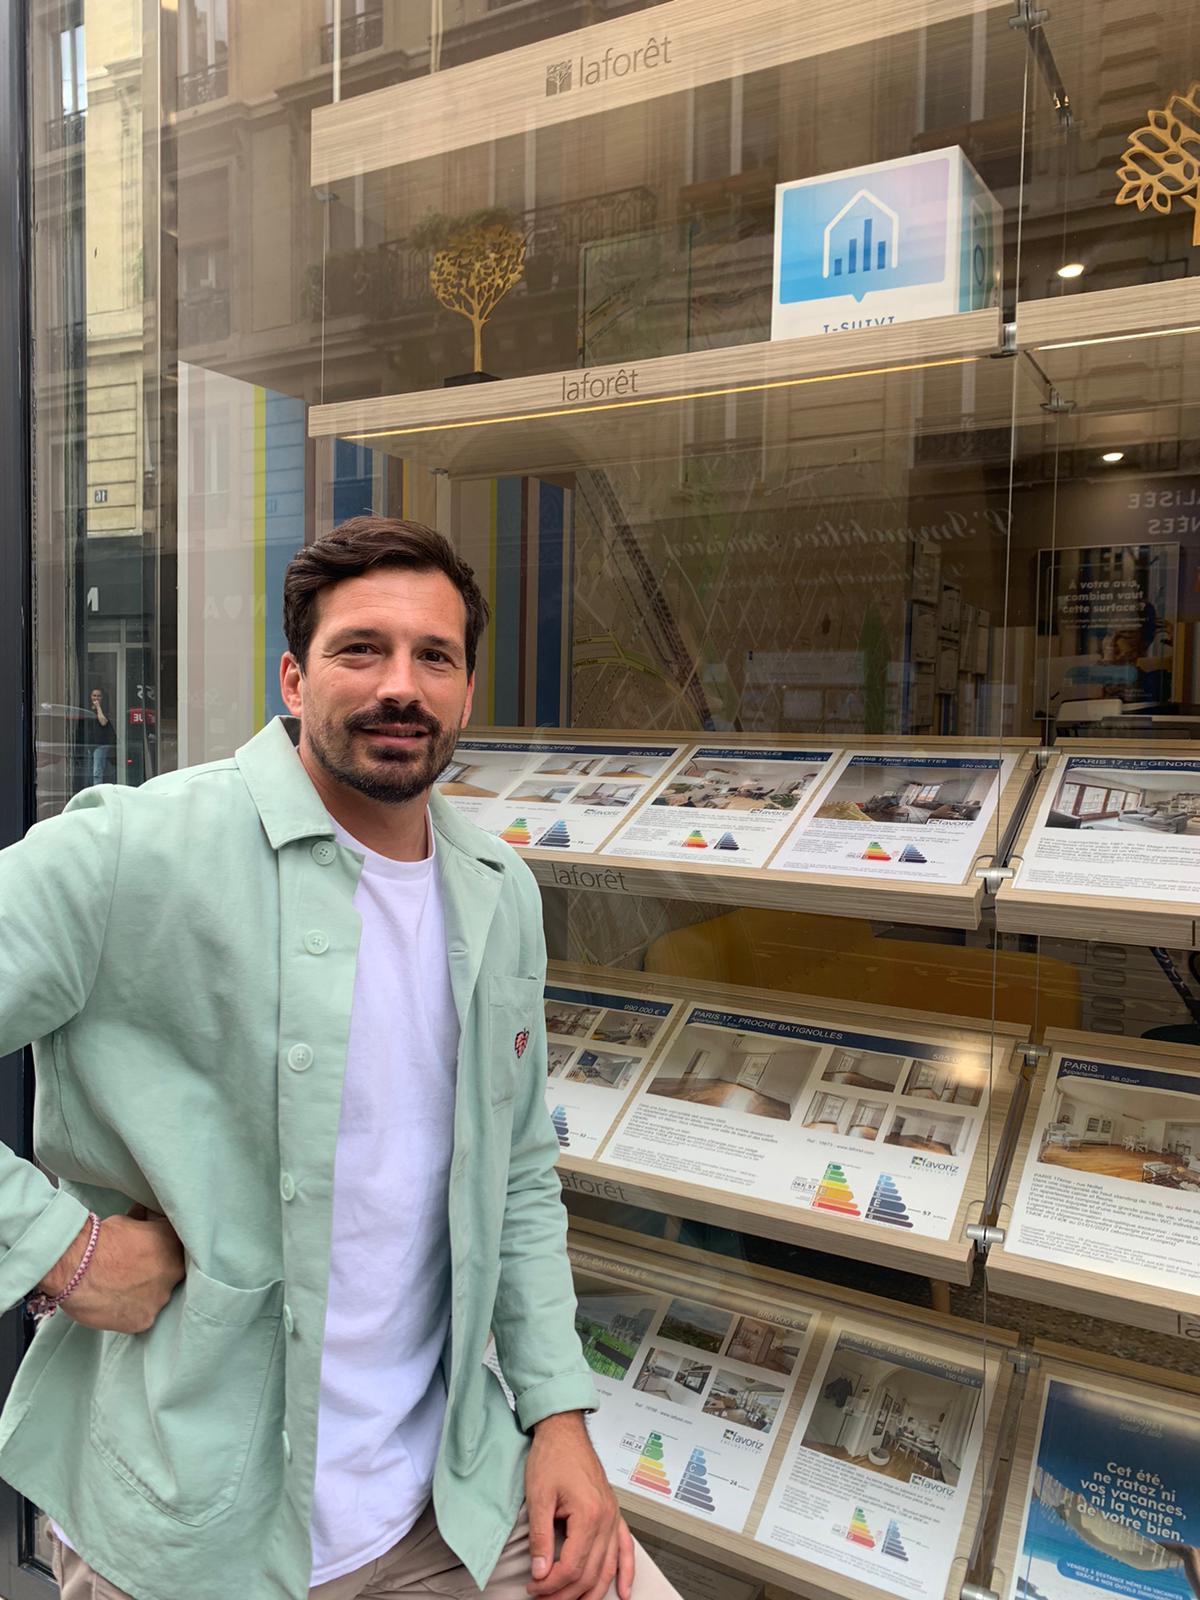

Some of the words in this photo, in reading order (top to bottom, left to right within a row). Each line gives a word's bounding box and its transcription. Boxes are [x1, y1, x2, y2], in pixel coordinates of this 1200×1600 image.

[579, 35, 673, 89] laforêt
[562, 368, 639, 402] laforêt
[1065, 591, 1114, 602] combien
[1117, 590, 1144, 601] vaut
[1080, 580, 1109, 590] votre
[1062, 604, 1090, 614] cette
[1093, 602, 1136, 613] surface
[1133, 760, 1200, 769] LEGENDRE
[551, 864, 629, 892] laforêt
[694, 1010, 720, 1020] PARIS
[722, 1013, 732, 1022] 17
[738, 1017, 776, 1030] PROCHE
[778, 1024, 844, 1041] BATIGNOLLES
[1064, 1060, 1099, 1073] PARIS
[921, 1157, 960, 1174] favoriz
[561, 1174, 627, 1202] aforêt
[732, 1429, 765, 1451] favoriz
[922, 1475, 956, 1498] favoriz
[1093, 1471, 1111, 1486] ne
[1116, 1475, 1157, 1498] ratez
[1161, 1489, 1177, 1503] ni
[1107, 1461, 1132, 1477] Cet
[1136, 1469, 1165, 1490] été,
[1080, 1479, 1106, 1495] vos
[1111, 1489, 1188, 1521] vacances,
[1091, 1494, 1106, 1508] ni
[1110, 1499, 1125, 1513] la
[1130, 1506, 1174, 1527] vente
[1076, 1502, 1097, 1517] de
[1101, 1509, 1142, 1531] votre
[1146, 1521, 1186, 1544] bien.
